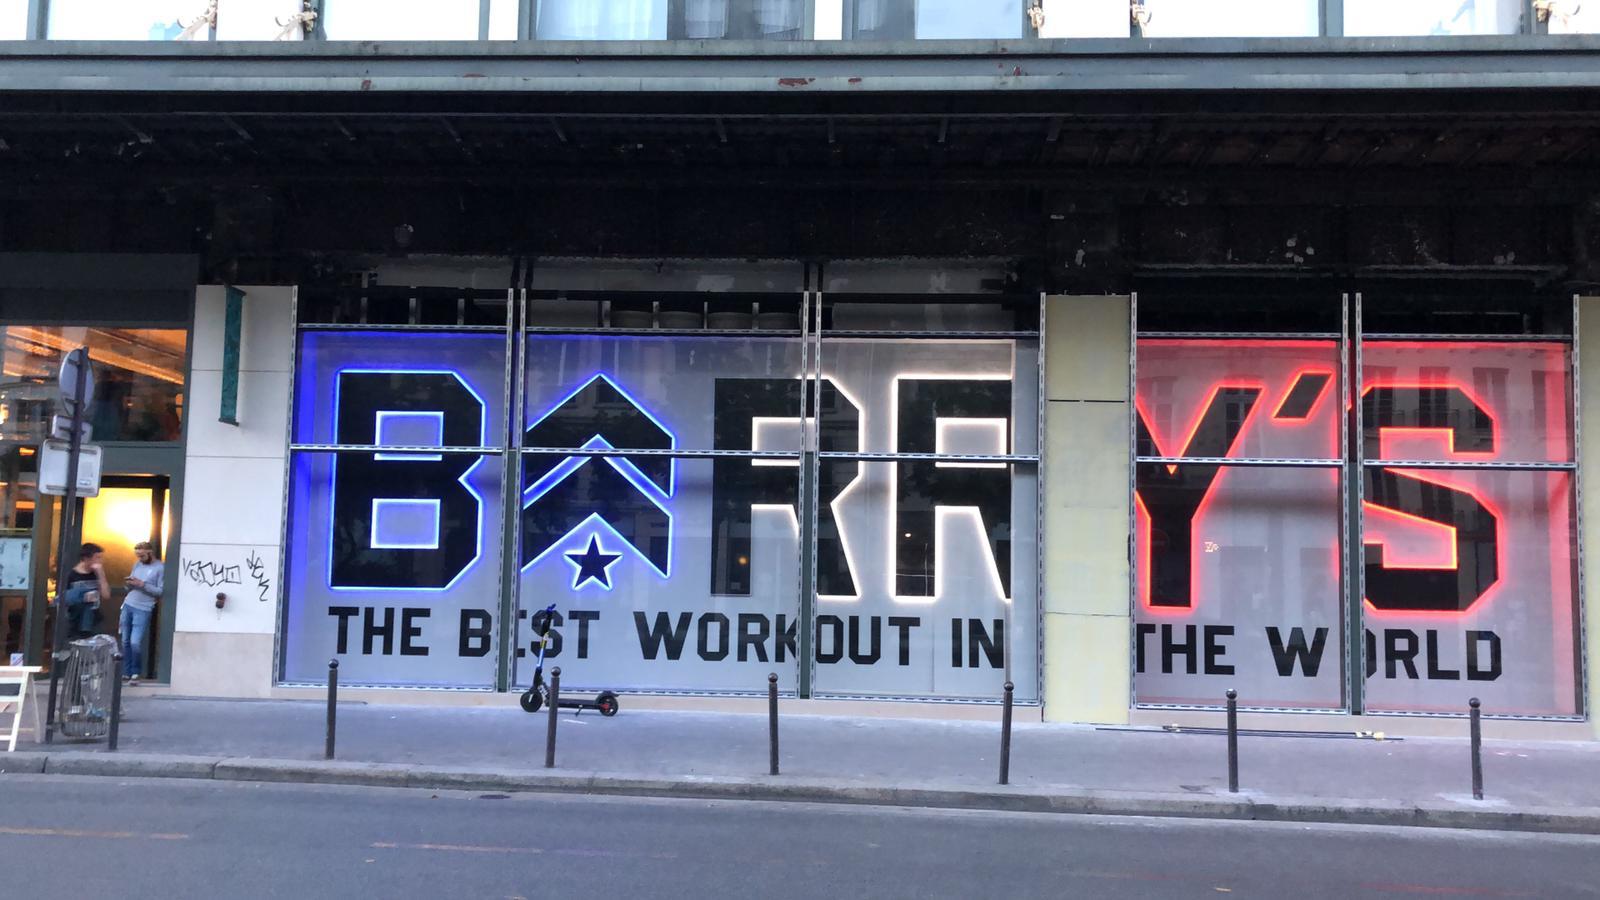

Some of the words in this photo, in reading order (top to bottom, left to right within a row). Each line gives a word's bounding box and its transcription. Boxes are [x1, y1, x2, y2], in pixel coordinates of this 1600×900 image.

[328, 606, 431, 656] THE
[633, 611, 921, 666] WORKOUT
[951, 617, 1005, 669] IN
